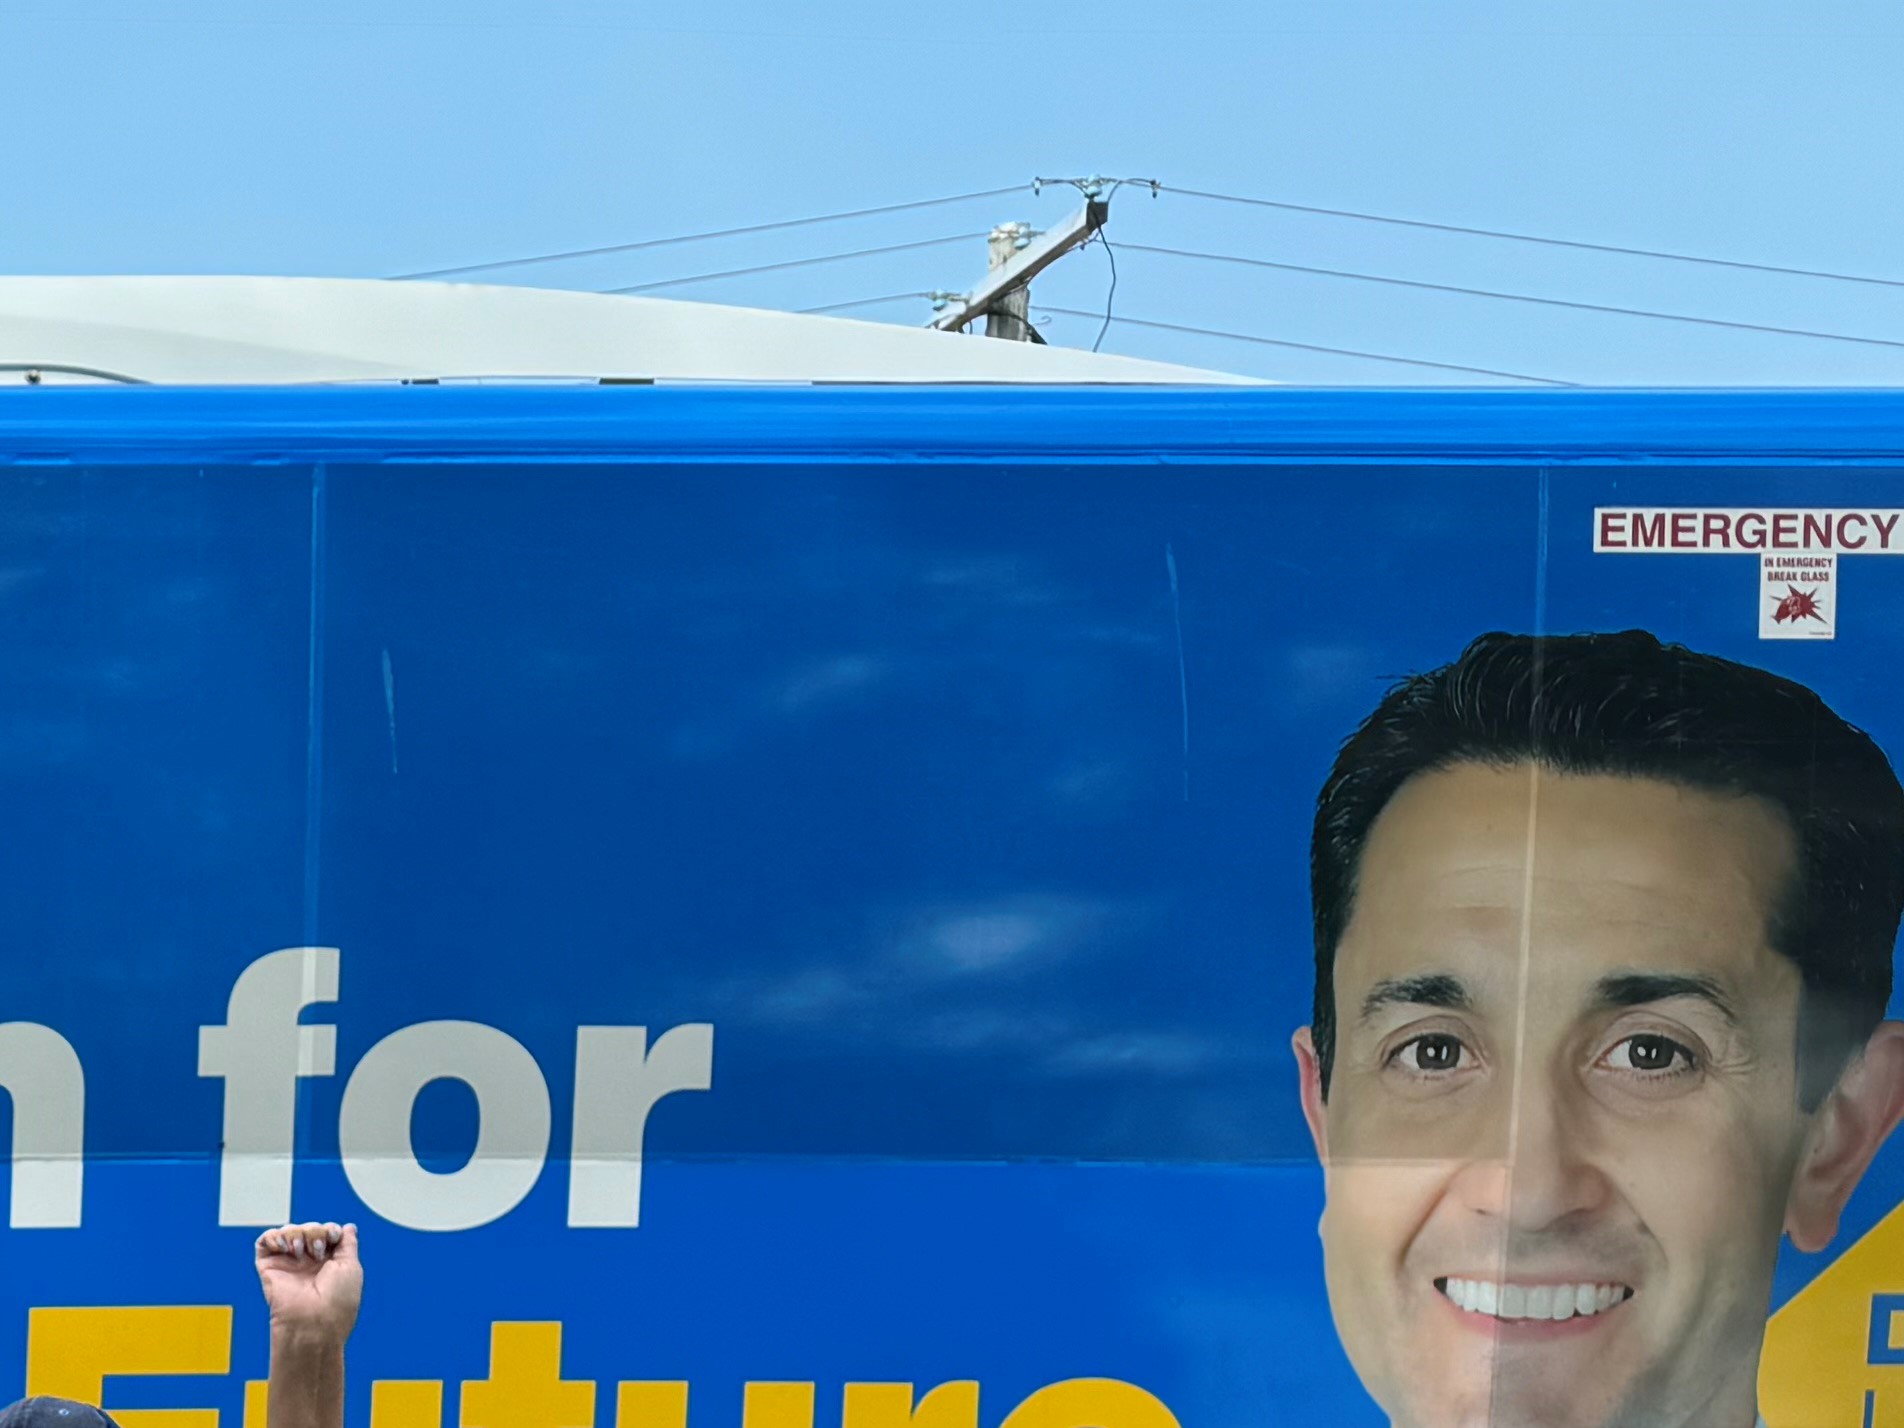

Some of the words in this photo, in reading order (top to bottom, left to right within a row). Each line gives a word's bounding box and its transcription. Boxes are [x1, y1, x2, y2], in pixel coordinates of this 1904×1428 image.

[1600, 512, 1900, 549] EMERGENCY
[1764, 557, 1775, 568] IN
[1776, 557, 1833, 569] EMERGENCY
[1767, 571, 1799, 583] BREAK
[1800, 571, 1830, 583] GLASS
[197, 944, 716, 1233] for
